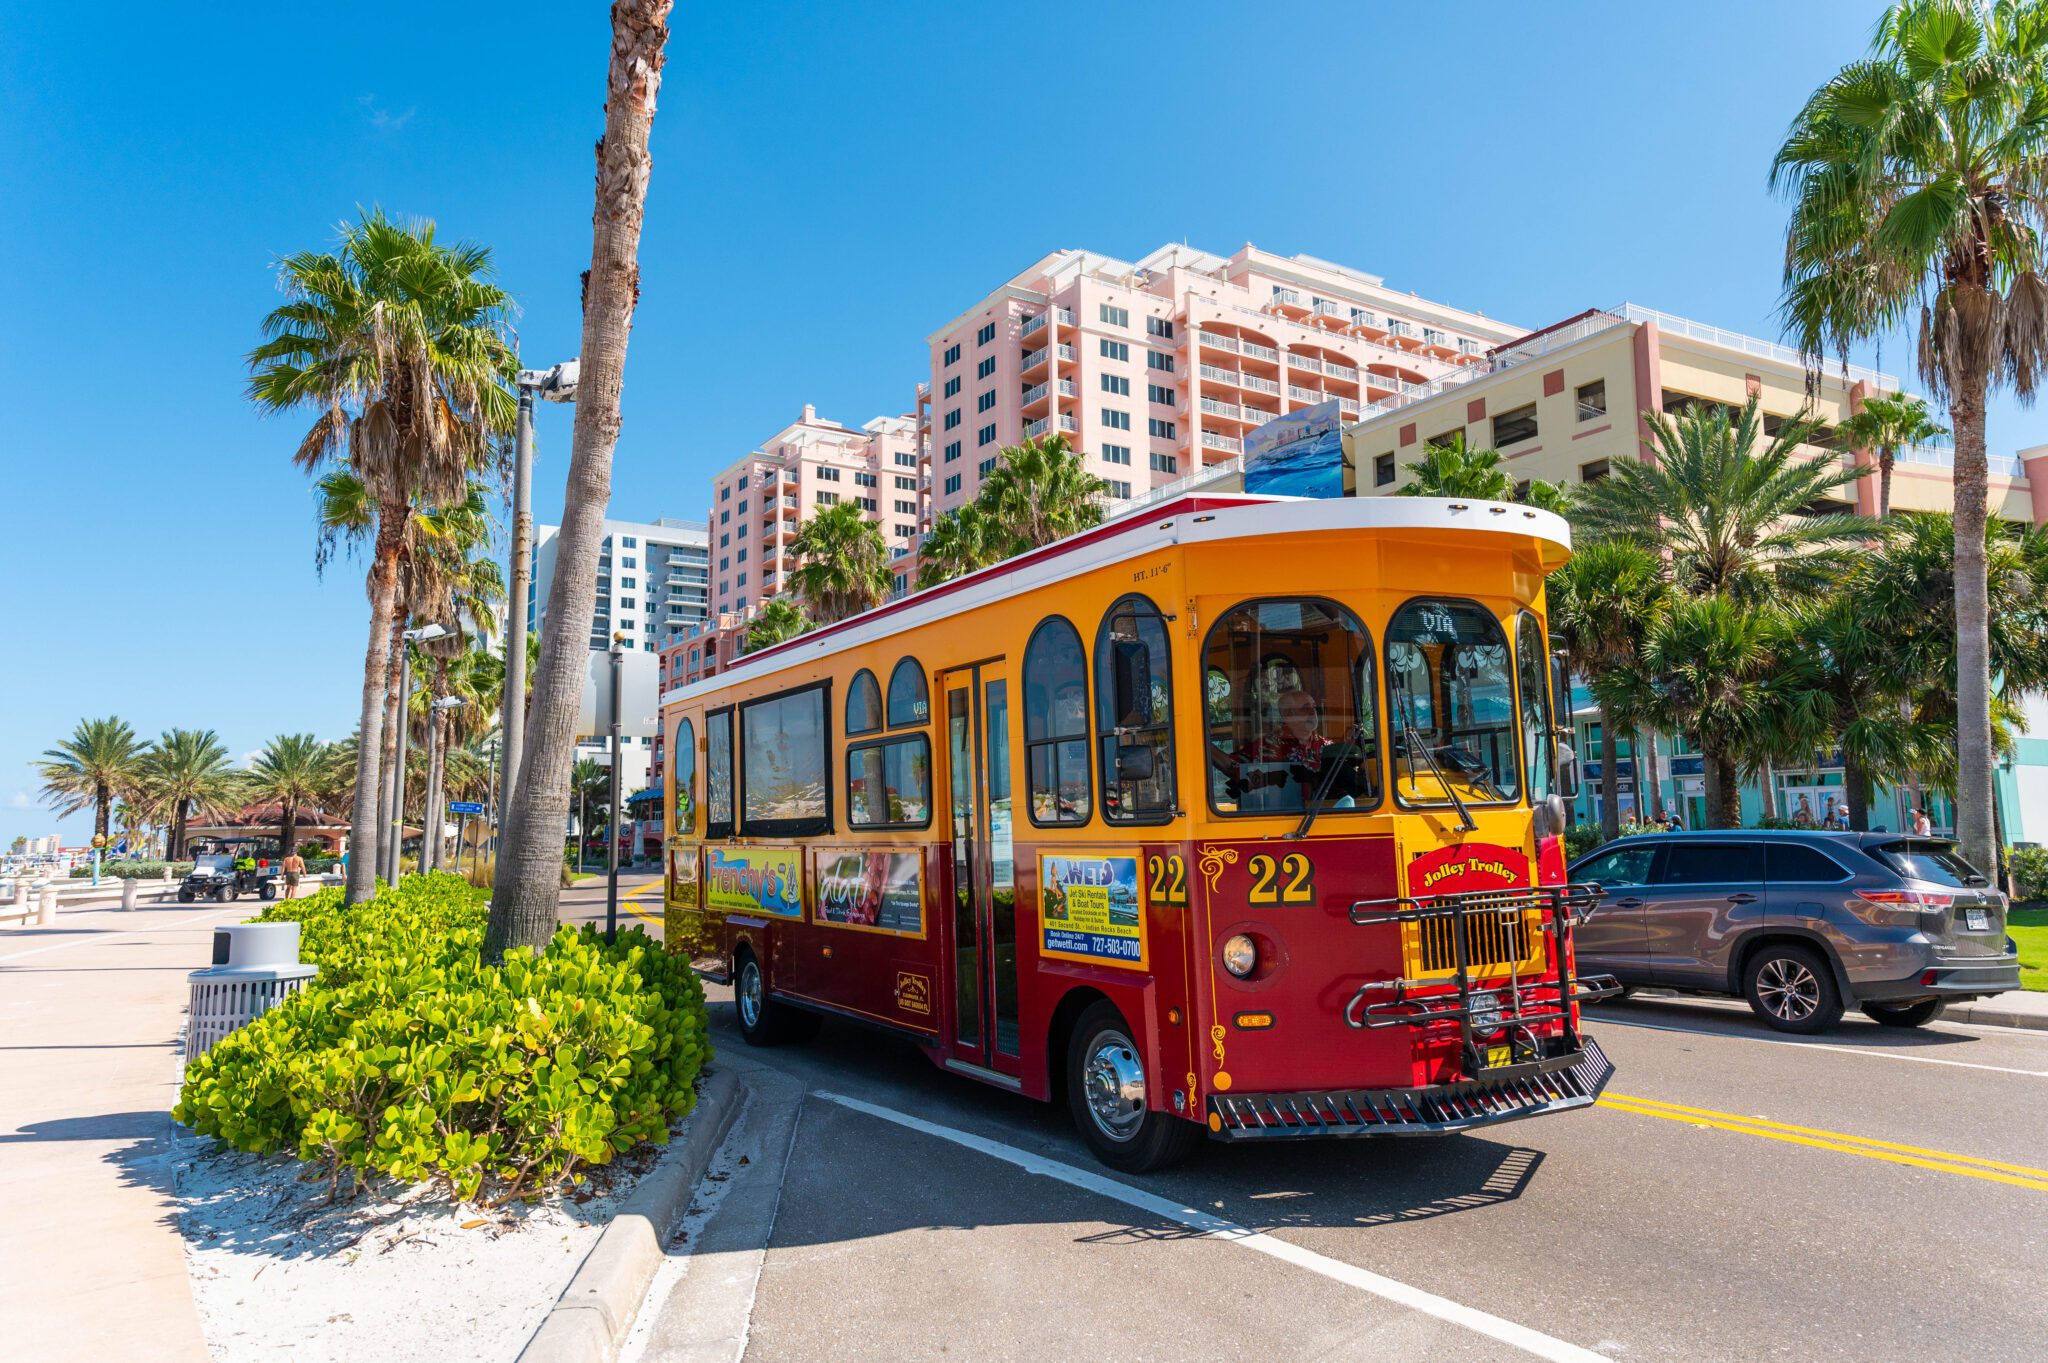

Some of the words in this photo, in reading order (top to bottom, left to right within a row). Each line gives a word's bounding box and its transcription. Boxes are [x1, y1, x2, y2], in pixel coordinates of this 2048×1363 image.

[1134, 570, 1148, 582] HT.
[1424, 614, 1453, 632] VIA
[913, 701, 927, 715] VIA
[710, 853, 776, 905] Frenchy's
[1149, 854, 1188, 905] 22
[1248, 853, 1316, 906] 22
[1424, 862, 1466, 887] Jolley
[1468, 858, 1518, 884] Trolley
[1078, 890, 1086, 898] Ski
[1087, 890, 1106, 900] Rentals
[1072, 899, 1076, 908] &
[1078, 900, 1089, 908] Boat
[1090, 900, 1104, 910] Tours
[1050, 930, 1061, 938] Book
[1086, 924, 1100, 932] Indian
[1101, 925, 1116, 933] Rocks
[1117, 926, 1132, 935] Beach
[1048, 938, 1088, 952] getwetfl.com
[1092, 937, 1140, 957] 727-503-0700
